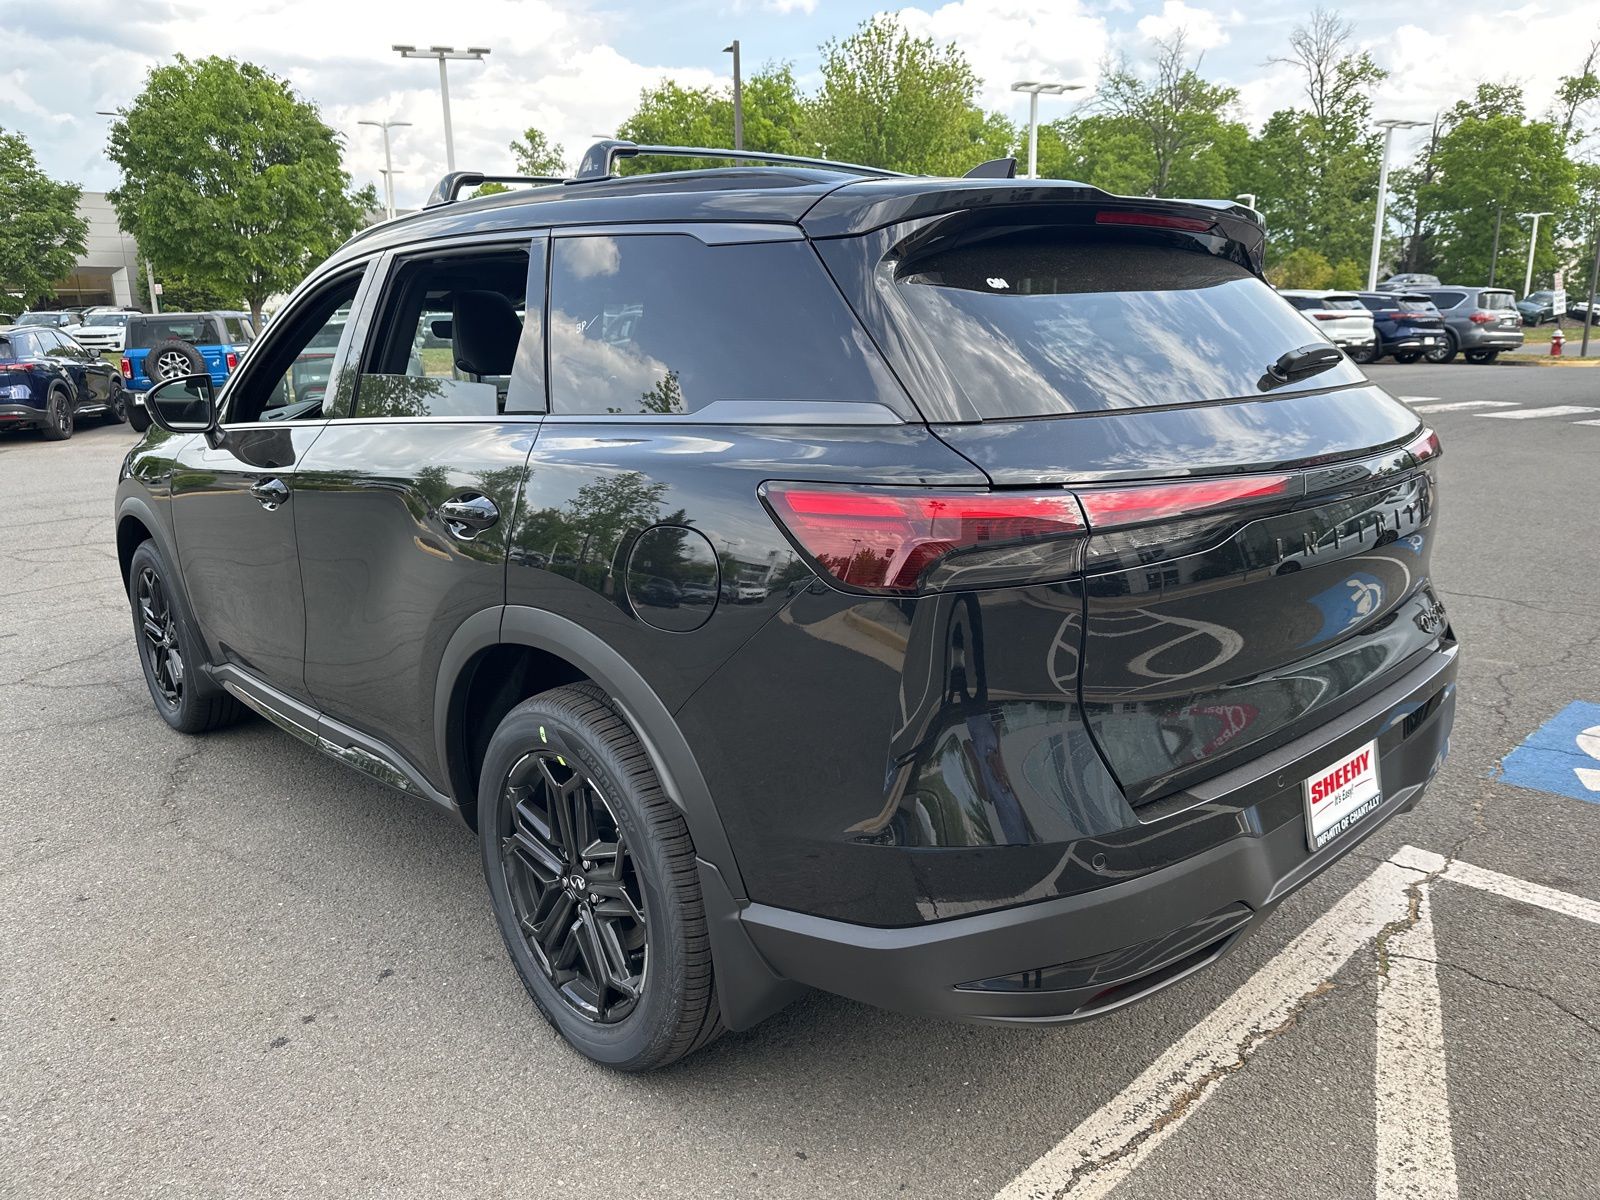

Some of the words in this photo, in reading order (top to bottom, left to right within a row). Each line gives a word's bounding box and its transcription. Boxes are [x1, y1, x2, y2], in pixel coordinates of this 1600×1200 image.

[1275, 498, 1428, 564] INFINITI
[1311, 749, 1370, 805] SHEEHY
[1341, 815, 1350, 830] OF
